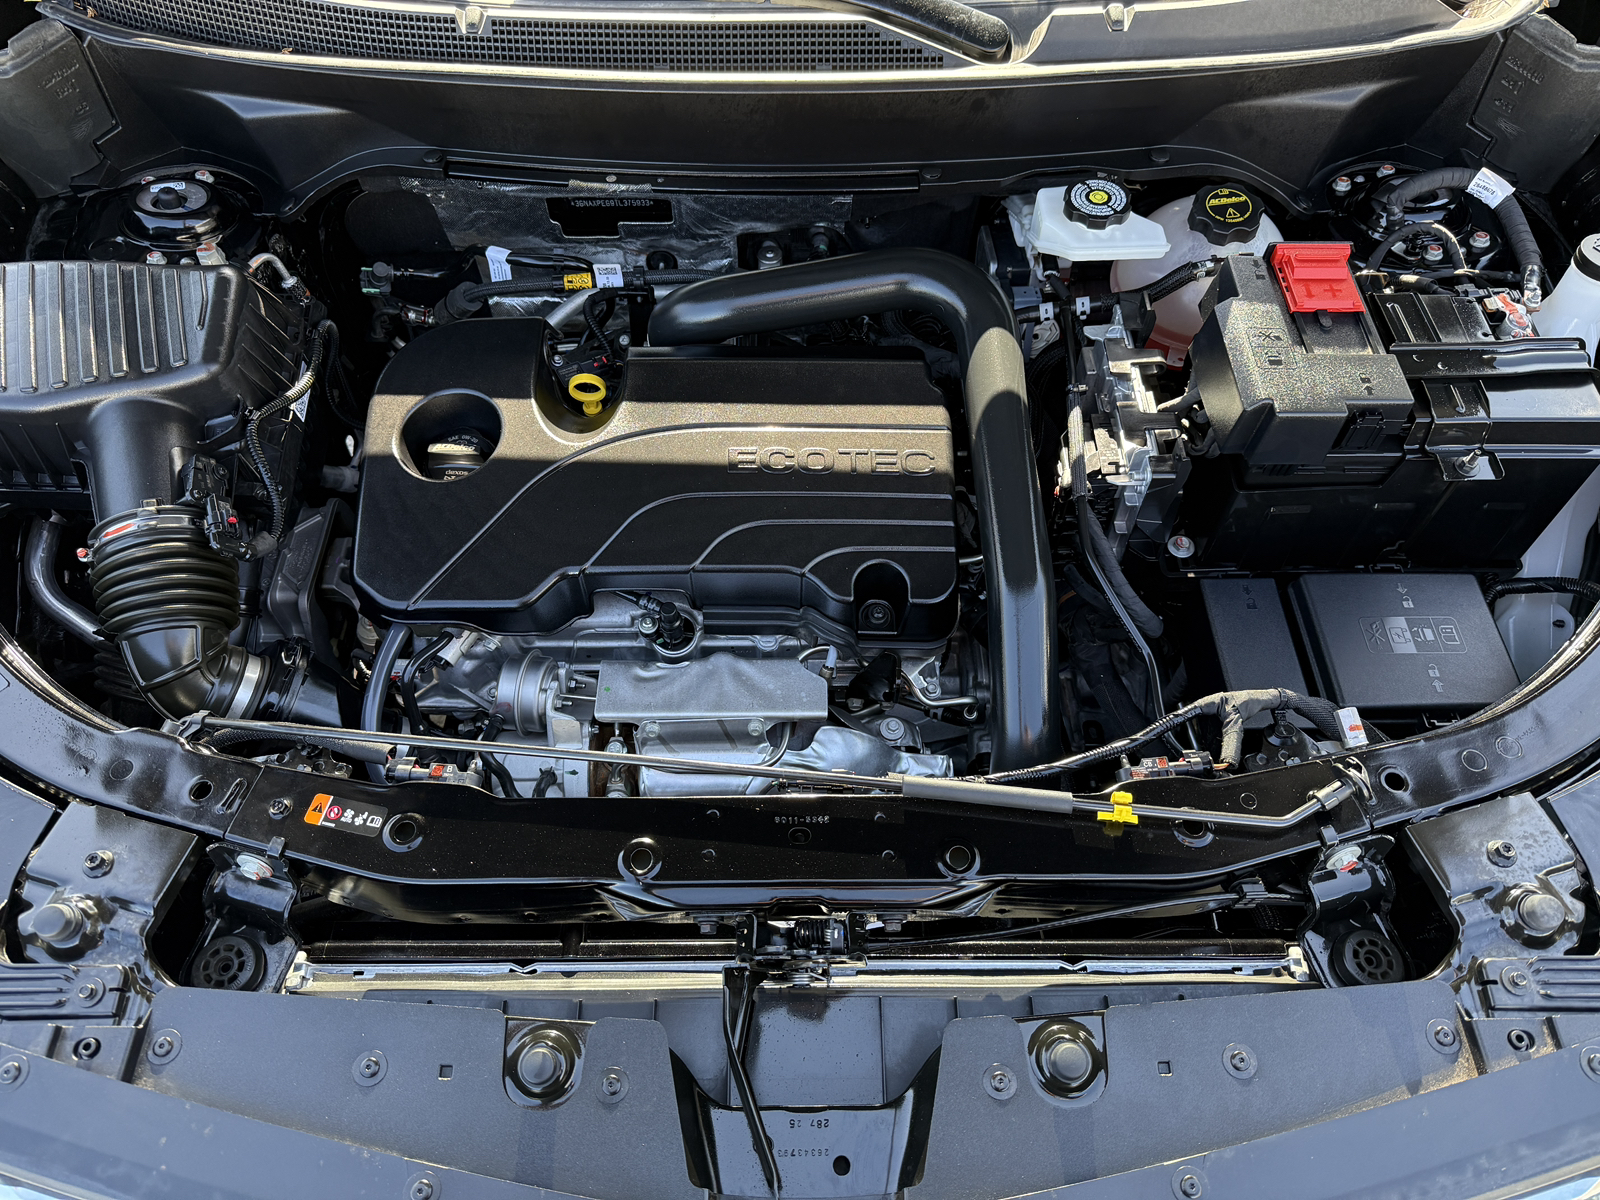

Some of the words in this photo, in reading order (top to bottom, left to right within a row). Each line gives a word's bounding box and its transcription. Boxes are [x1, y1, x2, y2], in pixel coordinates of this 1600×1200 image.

[1208, 196, 1246, 206] ACDelco
[461, 435, 479, 443] 0W-20
[727, 446, 936, 477] ECOTEC
[789, 1118, 802, 1129] 25
[810, 1118, 830, 1129] 287
